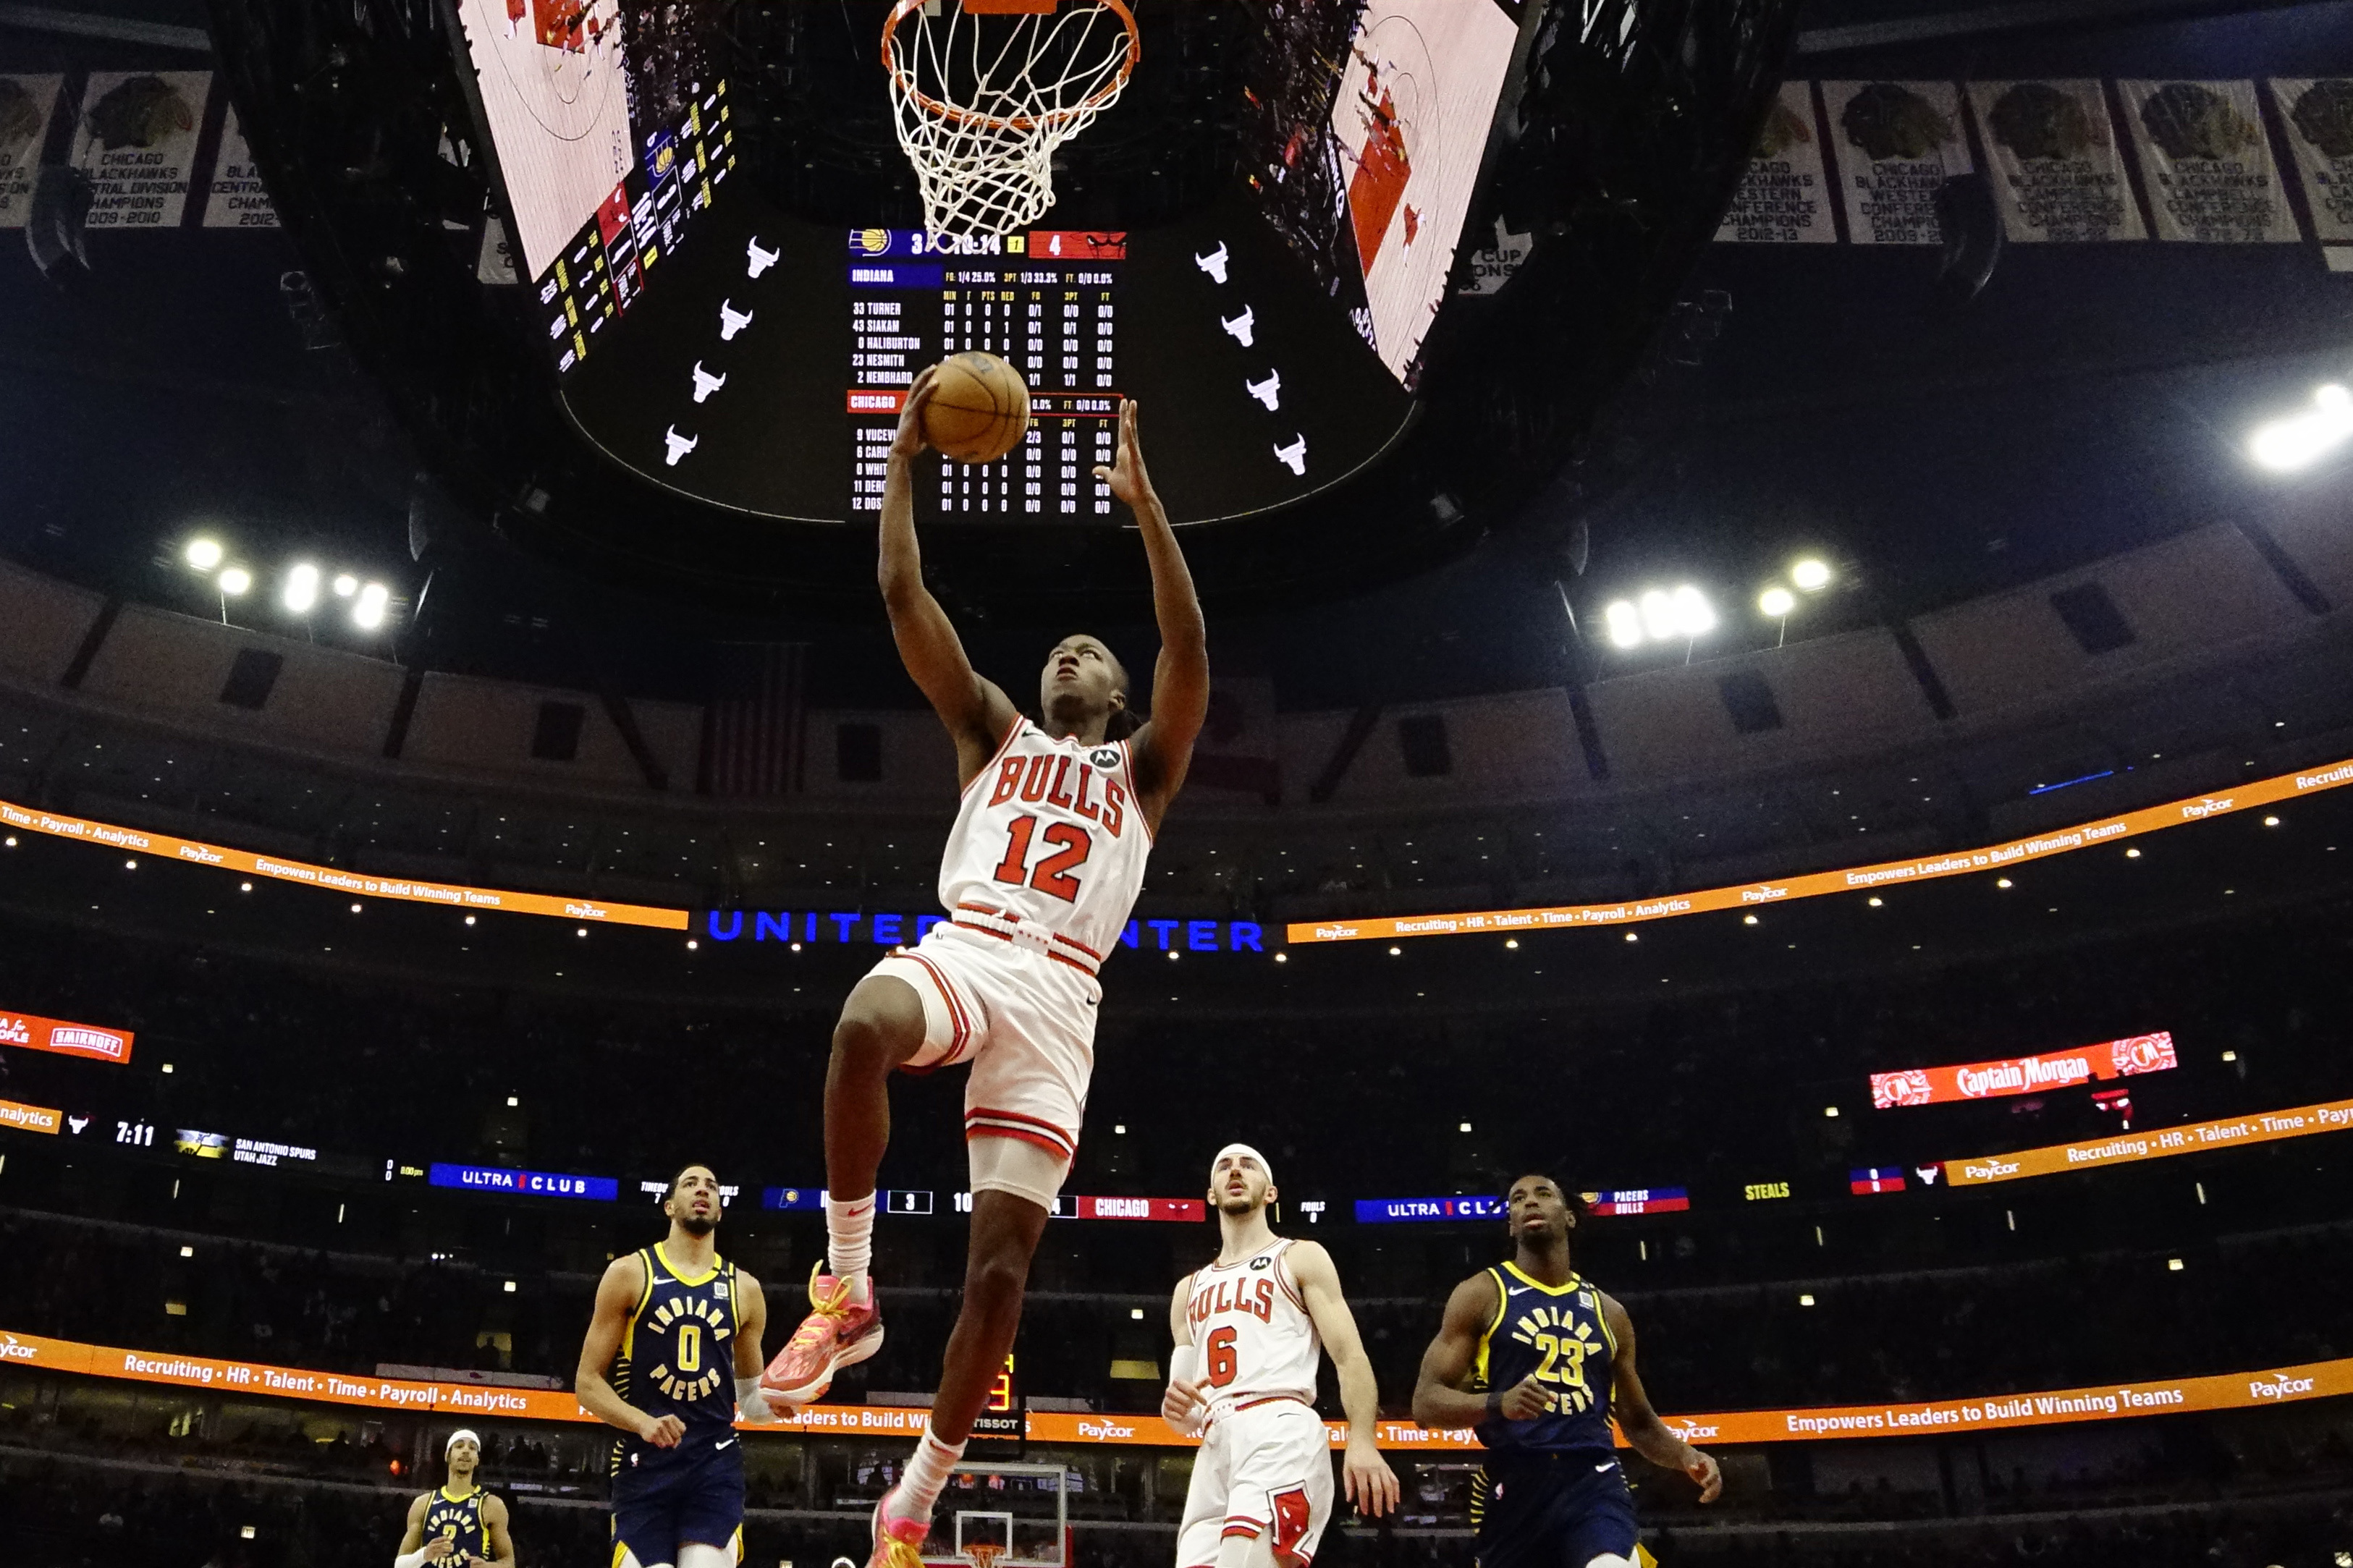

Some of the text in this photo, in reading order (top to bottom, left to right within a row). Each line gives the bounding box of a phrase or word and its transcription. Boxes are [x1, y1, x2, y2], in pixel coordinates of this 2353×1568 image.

[101, 153, 164, 165] CHICAGO
[82, 167, 177, 179] LACKHAWKS
[1872, 164, 1940, 175] CHICAGO
[130, 182, 187, 194] DIVISION
[1737, 189, 1801, 200] ESTERN
[90, 198, 164, 209] HAMPIONS
[1730, 202, 1817, 213] NFERENCE
[88, 212, 161, 224] 009-2010
[912, 234, 922, 254] 3
[1049, 235, 1060, 255] 4
[1482, 250, 1521, 262] CUP
[853, 269, 893, 281] INDIANA
[958, 271, 970, 283] 1/4
[972, 272, 995, 283] 25.0%
[1021, 271, 1032, 284] 1/3
[1034, 273, 1057, 283] 33.3%
[982, 291, 994, 300] PTS
[853, 302, 901, 315] 33 TURNER
[853, 320, 899, 332] 43 SIAKAM
[858, 337, 920, 349] 0 HALIBURTON
[853, 355, 904, 366] 23 NESMITH
[858, 372, 913, 383] 2 NEMBHARD
[851, 396, 895, 408] CHICAGO
[857, 429, 896, 441] 9 VUCEVI
[987, 755, 1125, 839] BULLS
[994, 815, 1092, 904] 12
[1317, 766, 2353, 940] Paycor Recruiting HR Talent Time Payroll Analytics Paycor Empowers Leaders to Build Winning Teams Paycor Recruiti
[2, 806, 606, 918] Time Payroll Analytics Paycor Empowers Leaders to Build Winning Teams Paycor
[1120, 919, 1264, 953] NTER
[9, 1020, 25, 1034] for
[55, 1031, 119, 1051] SMIRNOFF
[1957, 1062, 2023, 1097] Captain
[2019, 1056, 2090, 1090] Morgan
[0, 1108, 52, 1126] nalytics
[117, 1122, 153, 1145] 7:11
[236, 1138, 393, 1171] SAN ANTONIO SPURS 0
[1965, 1160, 2019, 1179] Paycor
[2067, 1140, 2147, 1162] Recruiting
[2160, 1132, 2184, 1148] HR
[2194, 1123, 2249, 1142] Talent
[2260, 1116, 2304, 1132] Time
[234, 1152, 392, 1181] UTAH JAZZ 0
[462, 1171, 585, 1193] ULTRA CLUB
[641, 1182, 739, 1197] TIMEOU OULS
[654, 1193, 729, 1207] 7 0
[1614, 1182, 1790, 1203] PACERS STEALS
[906, 1194, 914, 1210] 3
[1096, 1198, 1149, 1217] CHICAGO
[1301, 1201, 1325, 1213] FOULS
[1388, 1203, 1440, 1216] ULTRA
[1615, 1202, 1644, 1214] BULLS
[1310, 1212, 1317, 1223] 0
[648, 1296, 730, 1341] INDIANA
[1512, 1306, 1602, 1355] INDIANA
[678, 1325, 701, 1372] 0
[1207, 1326, 1238, 1389] 6
[1534, 1334, 1584, 1387] 23
[124, 1355, 213, 1382] Recruiting
[227, 1367, 250, 1383] HR
[264, 1370, 314, 1391] Talent
[328, 1378, 366, 1397] Time
[380, 1384, 438, 1404] Payroll
[451, 1389, 526, 1410] Analytics
[649, 1363, 721, 1401] PACERS
[1544, 1385, 1594, 1415] CERS
[1787, 1415, 1883, 1433] Empowers
[1886, 1408, 1959, 1427] Leaders
[1961, 1407, 1982, 1421] to
[1985, 1399, 2033, 1419] Build
[2035, 1394, 2117, 1414] Winning
[2118, 1390, 2183, 1407] Teams
[2249, 1374, 2313, 1399] Paycor
[841, 1412, 858, 1425] to
[862, 1412, 904, 1428] Build
[1078, 1419, 1134, 1440] Paycor
[1386, 1426, 1429, 1441] Time
[428, 1509, 476, 1534] INDIANA
